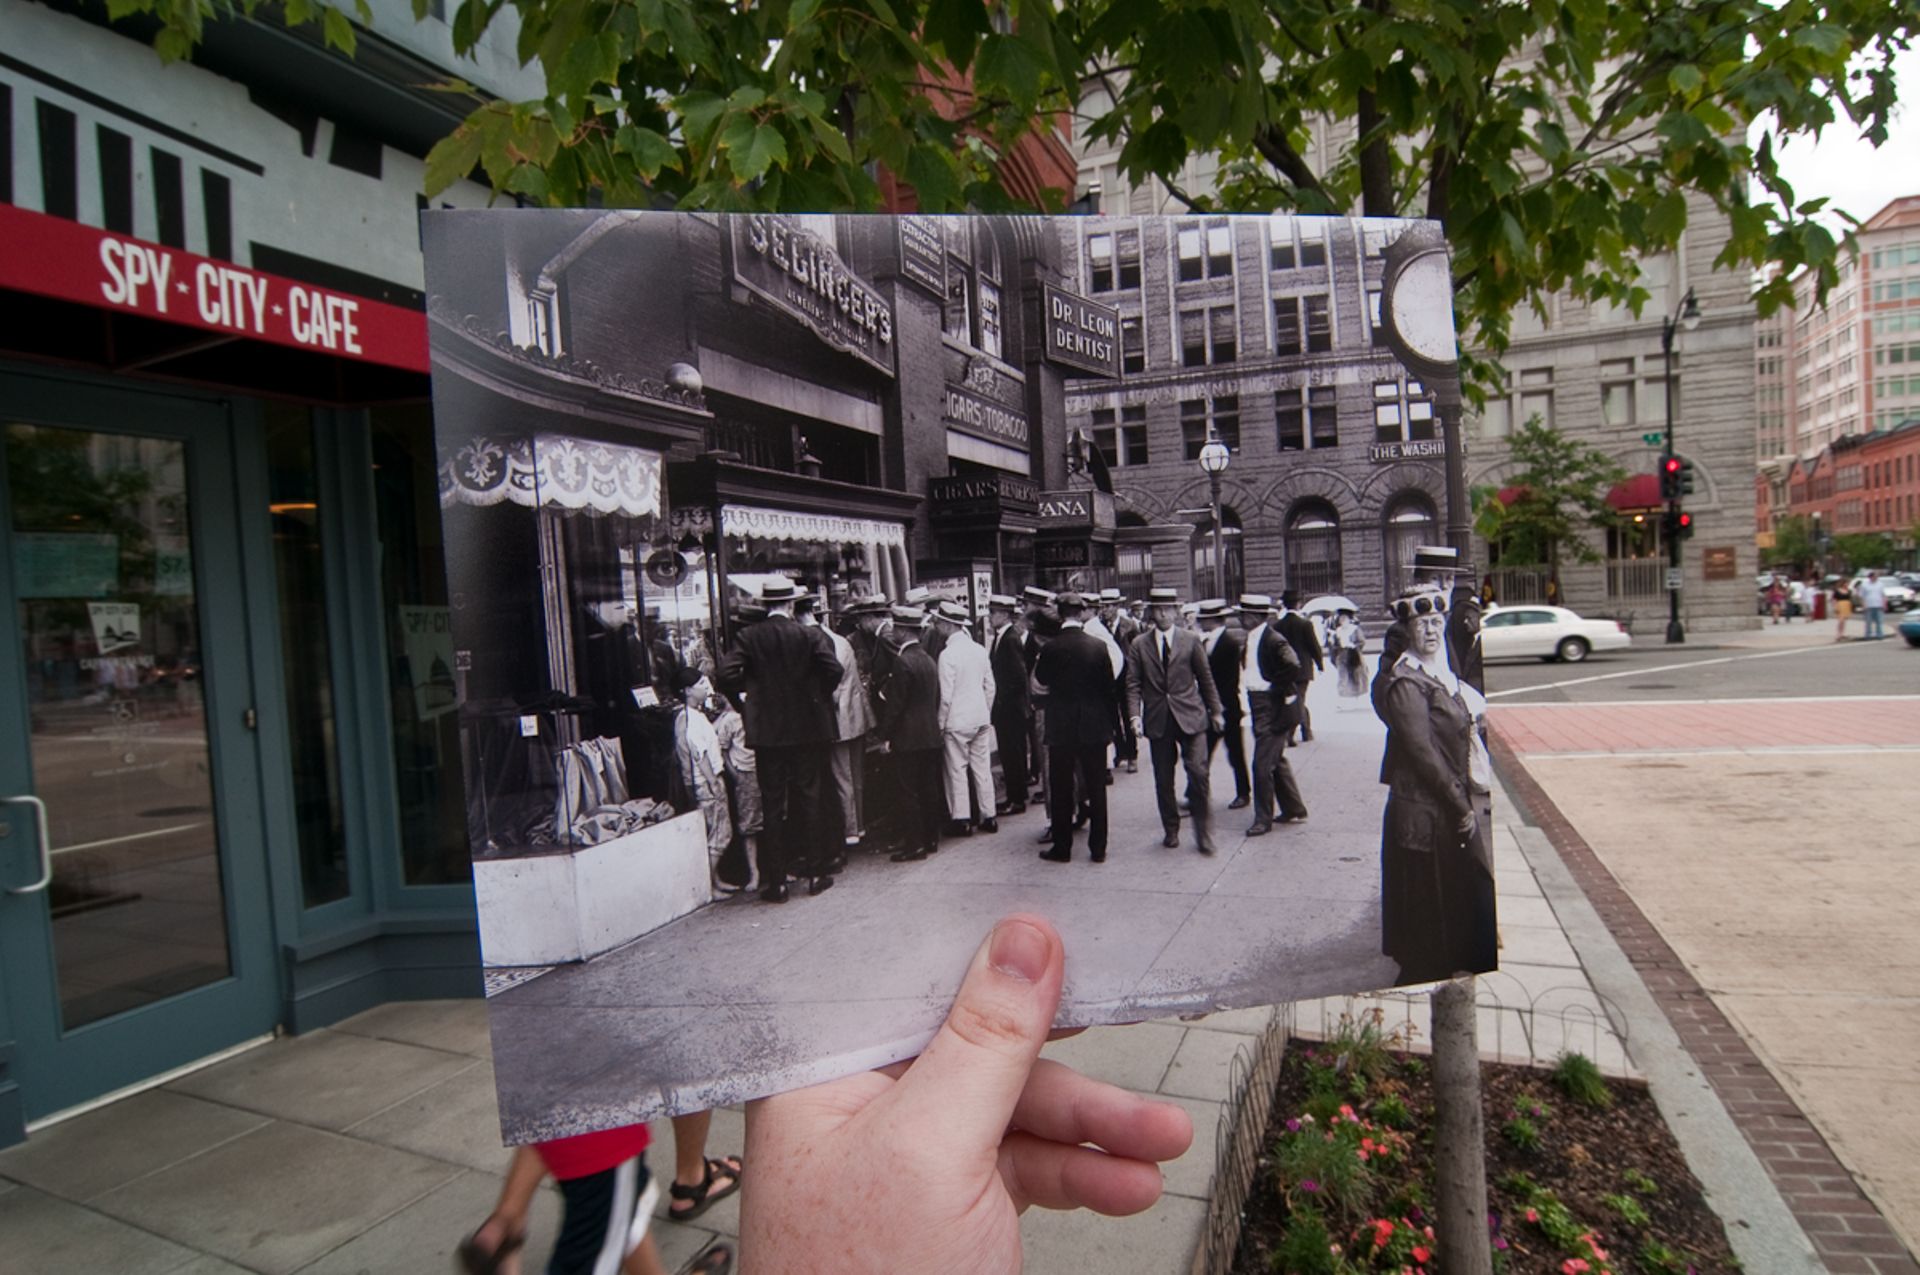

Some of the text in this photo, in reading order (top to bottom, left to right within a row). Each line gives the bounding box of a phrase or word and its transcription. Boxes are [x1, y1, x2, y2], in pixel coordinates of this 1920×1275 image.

[100, 237, 363, 355] SPY CITY CAFE
[749, 214, 891, 345] SELINGER'S
[1053, 297, 1114, 339] DR. LEON
[1056, 327, 1113, 363] DENTIST
[985, 406, 1028, 442] TOBACCO
[1373, 445, 1399, 459] THE
[933, 480, 998, 501] CIGARS
